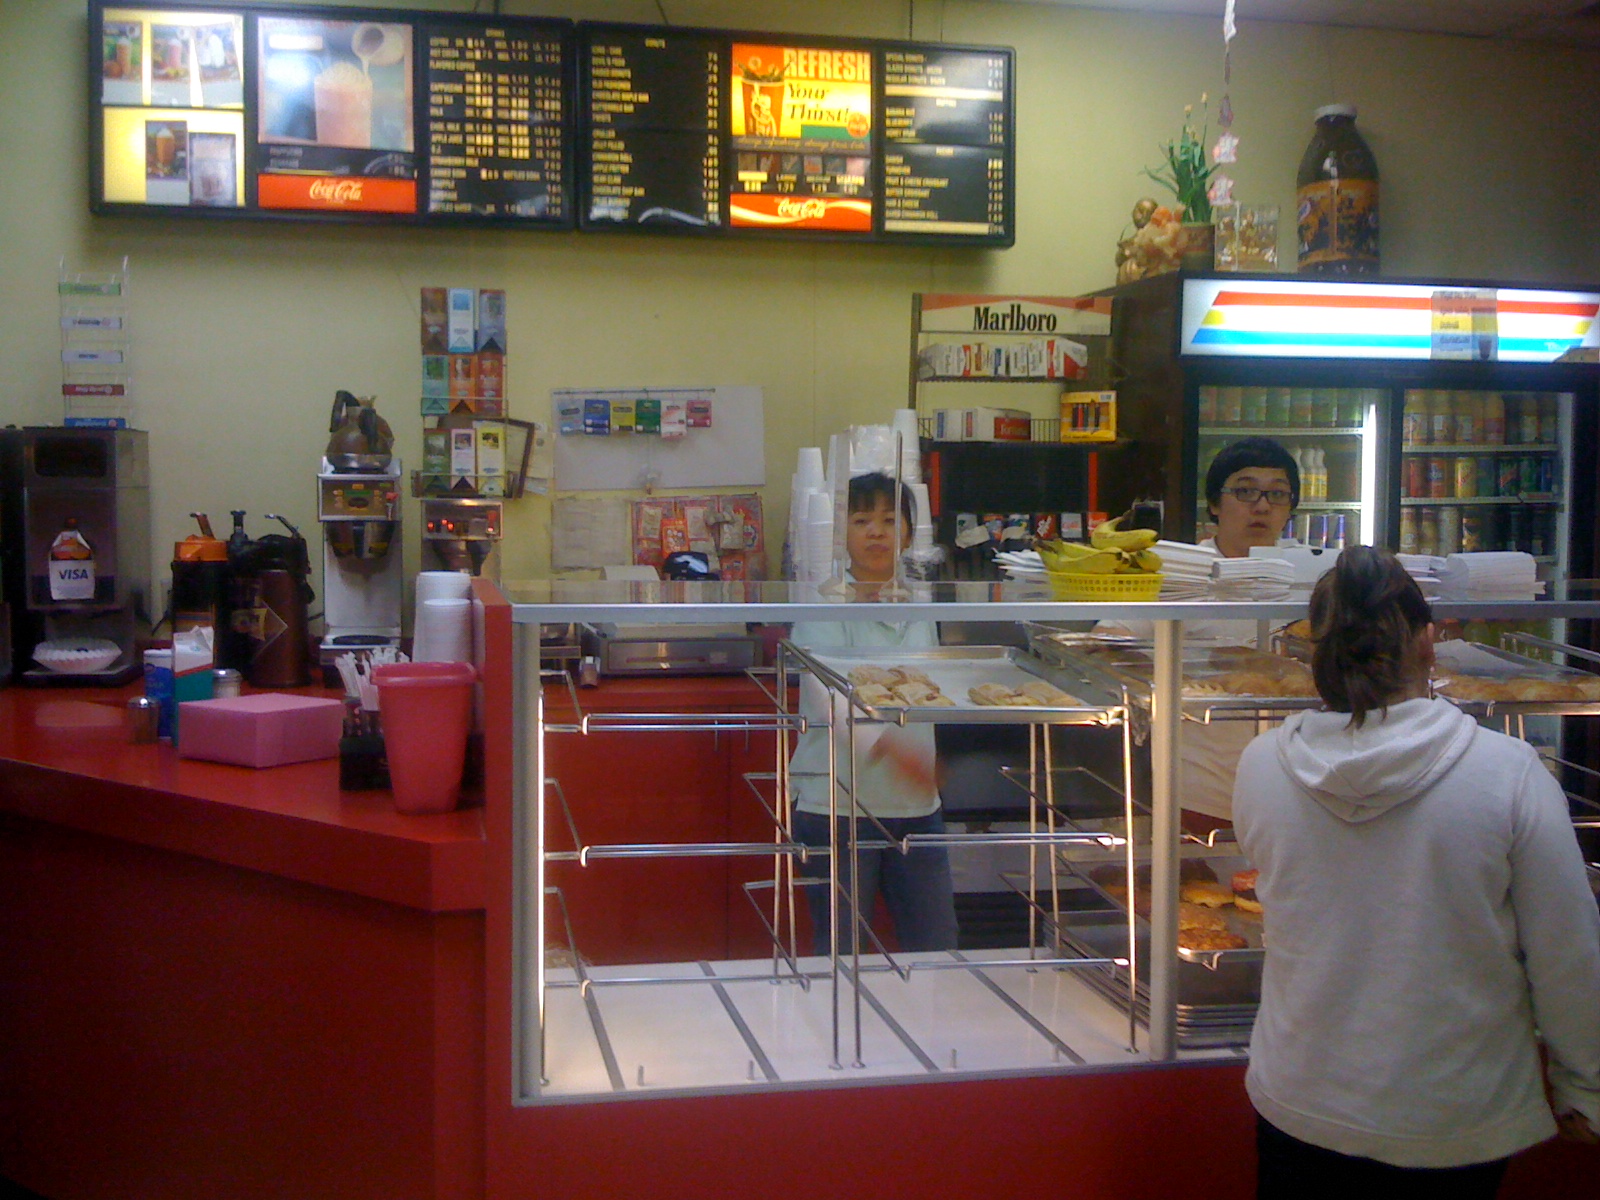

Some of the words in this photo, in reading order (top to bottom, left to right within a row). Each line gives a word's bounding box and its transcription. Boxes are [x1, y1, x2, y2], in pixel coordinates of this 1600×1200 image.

[784, 48, 871, 81] REFRESH
[788, 82, 829, 99] Your
[973, 304, 1057, 332] Marlboro
[58, 569, 89, 580] VISA
